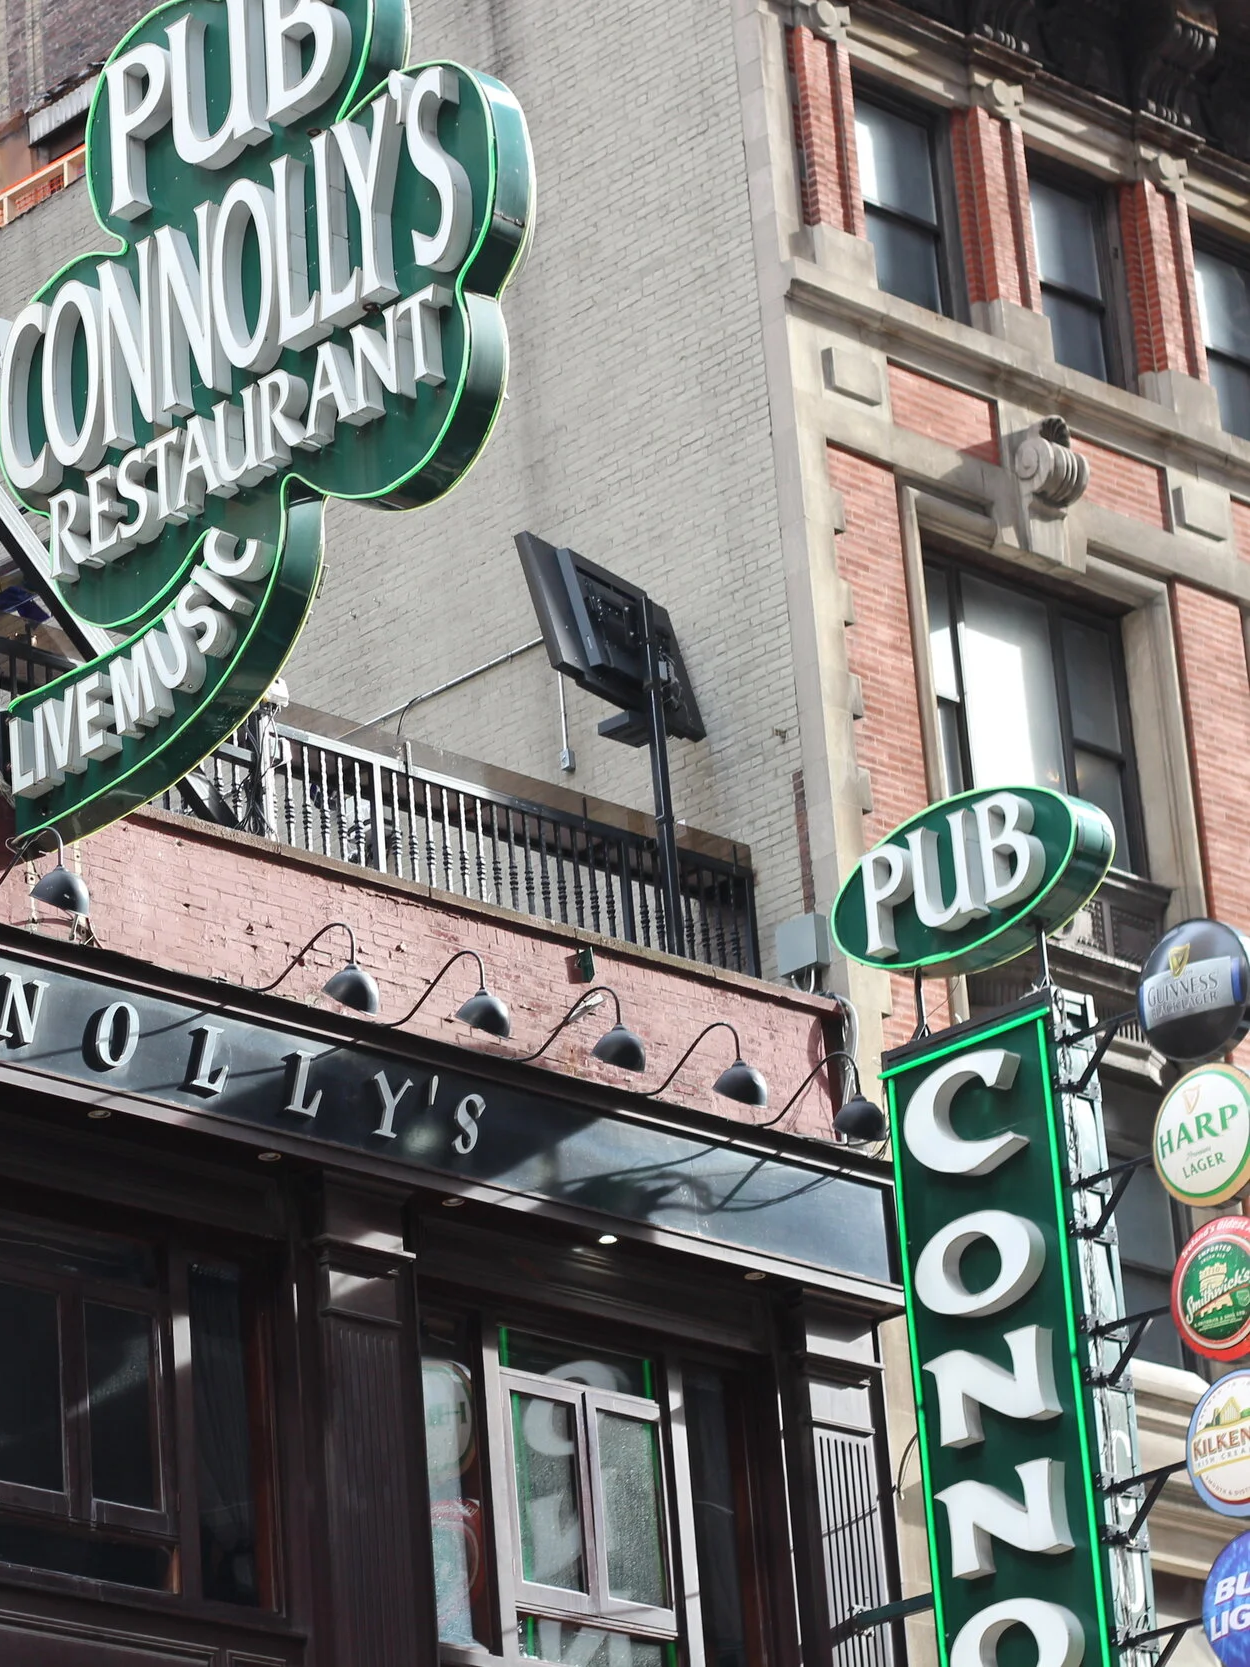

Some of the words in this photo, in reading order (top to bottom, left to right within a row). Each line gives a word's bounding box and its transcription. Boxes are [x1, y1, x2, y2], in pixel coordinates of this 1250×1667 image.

[104, 0, 352, 221] PUB
[1, 66, 473, 491] CONNOLLY'S
[48, 283, 453, 583] RESTAURANT
[10, 671, 122, 798] LIVE
[110, 527, 272, 739] MUSIC
[860, 792, 1046, 958] PUB
[1147, 973, 1218, 1008] GUINNESS
[1159, 1103, 1239, 1161] HARP
[1182, 1151, 1226, 1179] LAGER
[904, 1048, 1086, 1667] CONNO
[1185, 1266, 1250, 1325] Smithwick's
